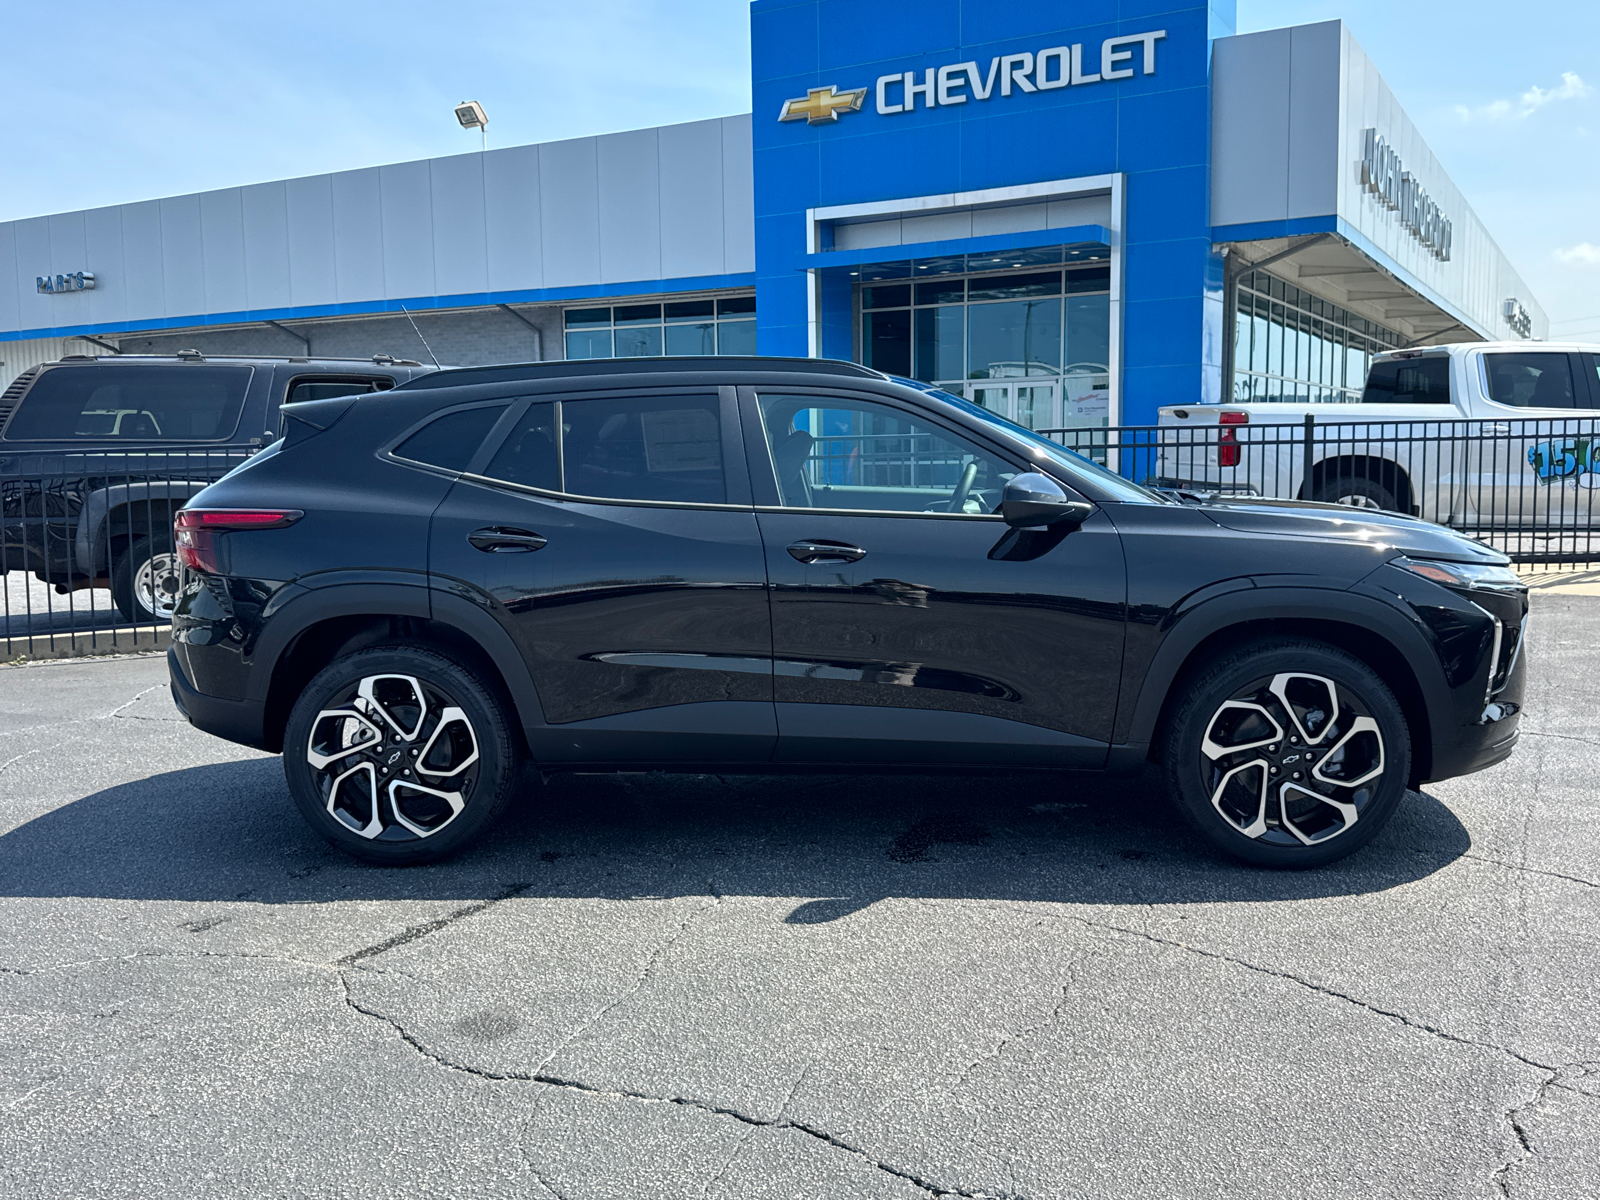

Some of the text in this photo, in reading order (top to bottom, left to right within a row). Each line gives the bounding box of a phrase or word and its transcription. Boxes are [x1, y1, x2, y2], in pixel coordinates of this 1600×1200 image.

[876, 29, 1167, 115] CHEVROLET
[1362, 127, 1402, 211] JOHN
[36, 271, 87, 293] PARTS
